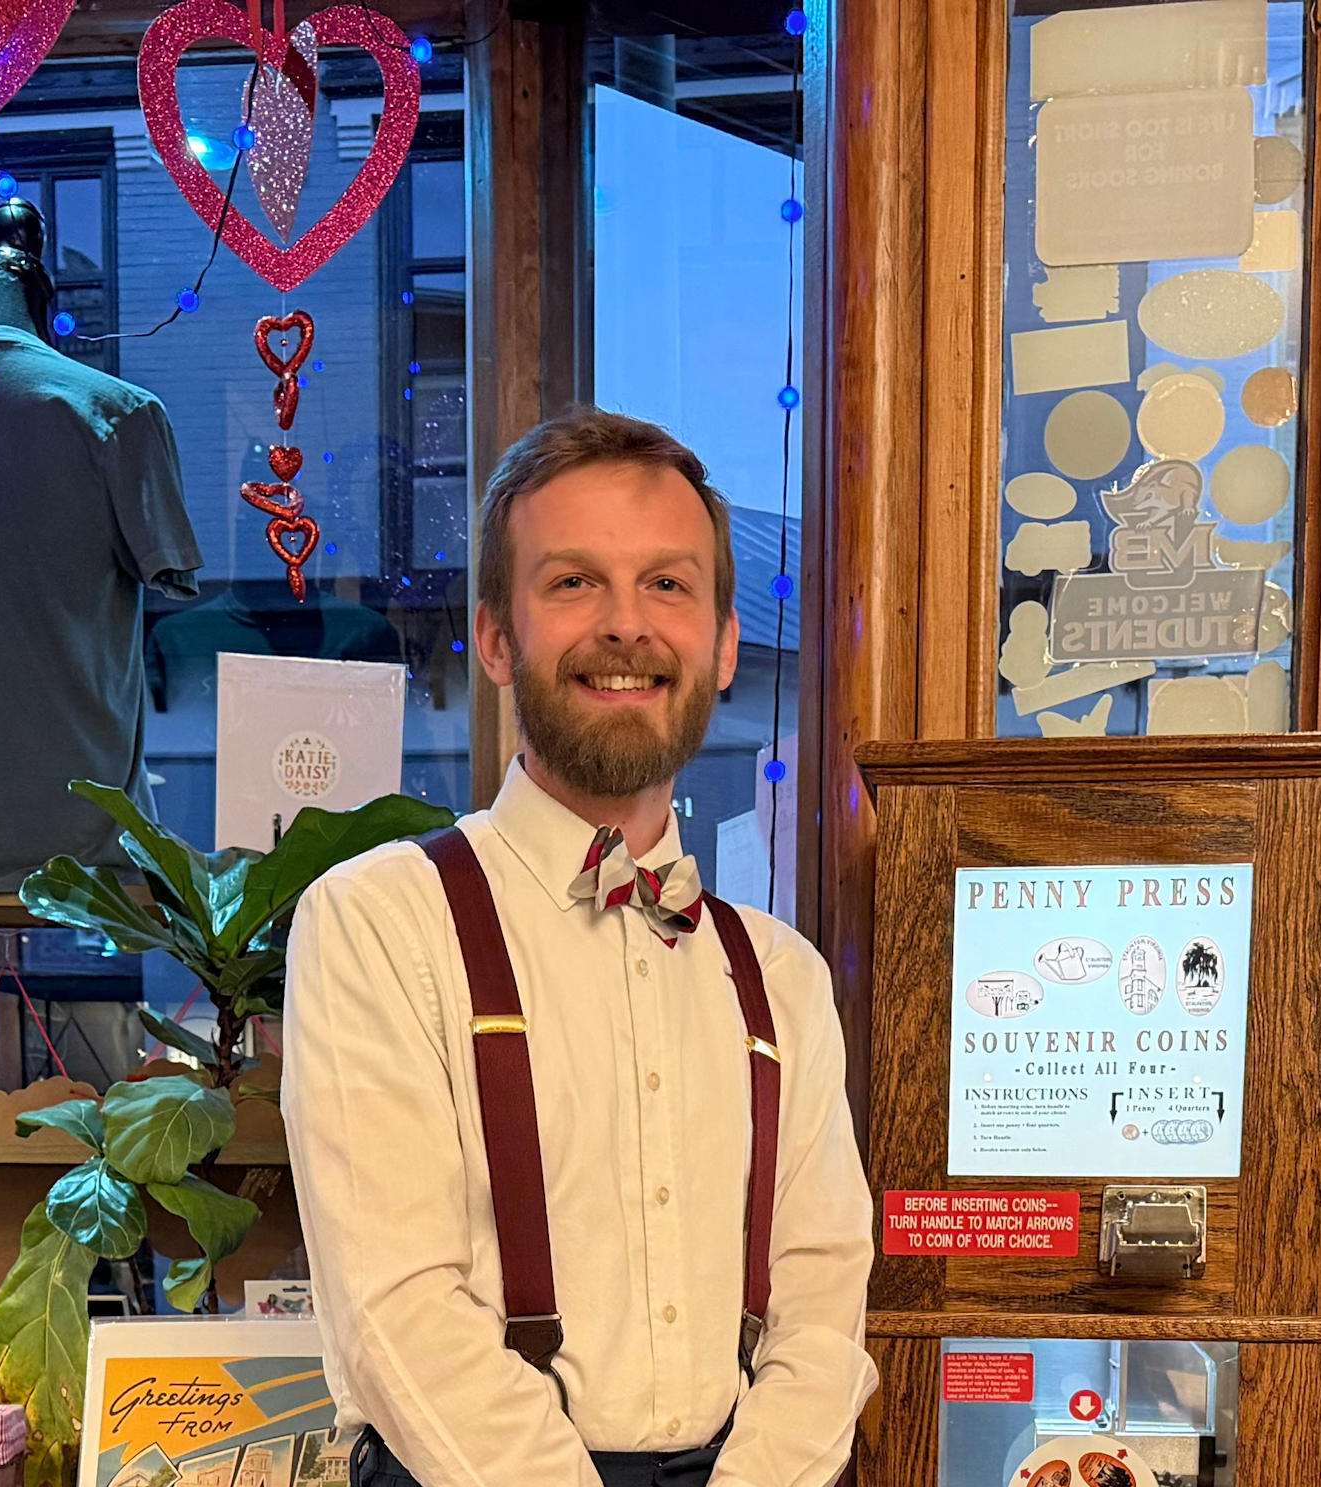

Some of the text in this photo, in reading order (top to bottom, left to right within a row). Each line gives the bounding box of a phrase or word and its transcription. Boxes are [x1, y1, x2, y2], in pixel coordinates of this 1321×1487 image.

[284, 749, 333, 765] KATIE
[284, 764, 331, 780] DAISY
[968, 876, 1235, 909] PENNY PRESS
[965, 1029, 1228, 1053] SOUVENIR COINS
[1095, 1061, 1118, 1075] All
[965, 1087, 1089, 1101] INSTRUCTIONS
[1128, 1086, 1211, 1100] INSERT
[1133, 1105, 1155, 1113] Penny
[1175, 1104, 1210, 1113] Quarters
[905, 1197, 947, 1212] BEFORE
[951, 1197, 1008, 1212] INSERTING
[889, 1215, 1074, 1231] TURN HANDLE TO MATCH ARROWS
[908, 1233, 1053, 1249] TO COIN OF YOUR CHOICE.
[109, 1376, 244, 1434] Greetings
[158, 1410, 234, 1437] FROM
